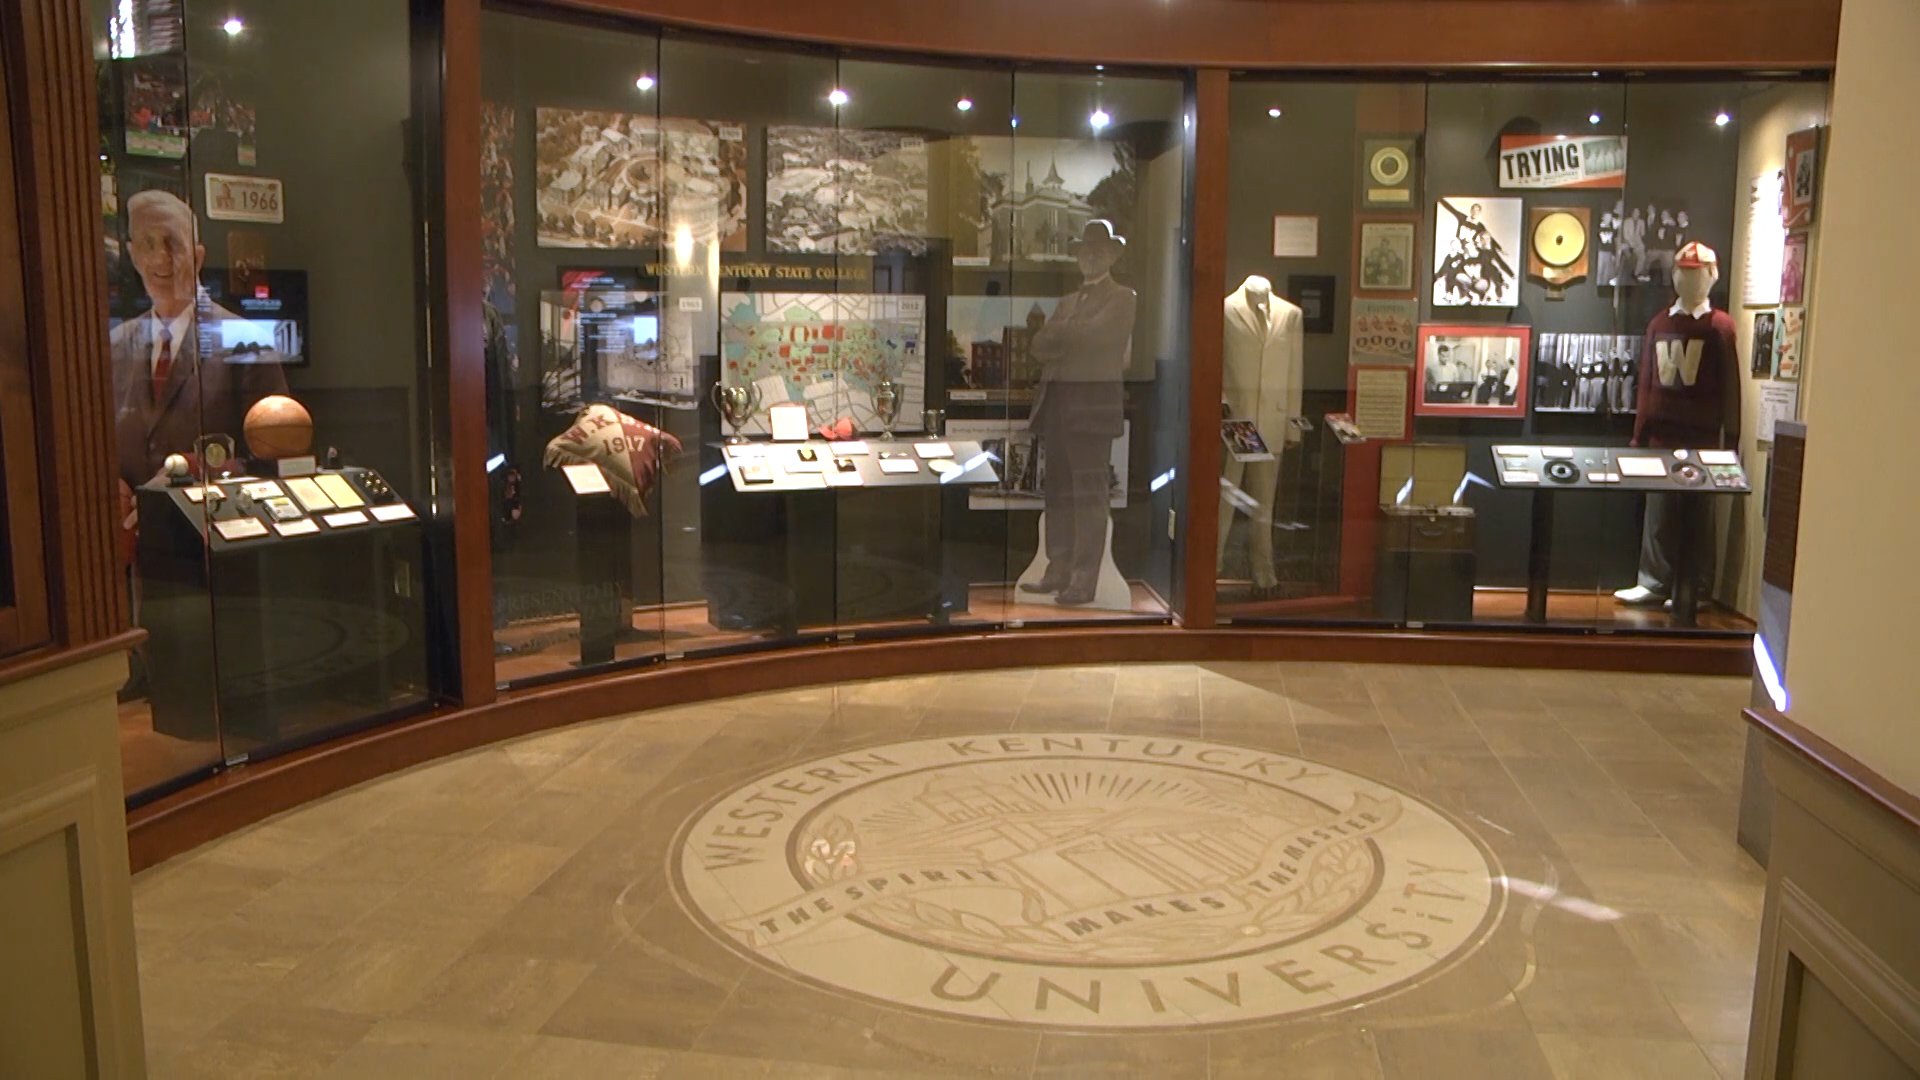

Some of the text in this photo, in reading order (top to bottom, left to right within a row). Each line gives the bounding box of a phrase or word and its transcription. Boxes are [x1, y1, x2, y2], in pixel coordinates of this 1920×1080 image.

[1503, 143, 1580, 180] TRYING
[242, 191, 278, 210] 1966
[711, 264, 771, 279] ENTUCKY
[775, 265, 812, 279] STATE
[1655, 339, 1705, 386] W
[603, 435, 645, 456] 1917
[704, 736, 1330, 871] WESTERN KENTUCKY
[1248, 812, 1381, 893] THE MASTER
[760, 868, 1000, 935] THE SPIRIT
[1064, 896, 1227, 937] MAKES
[930, 859, 1469, 1014] UNIVERSITY
